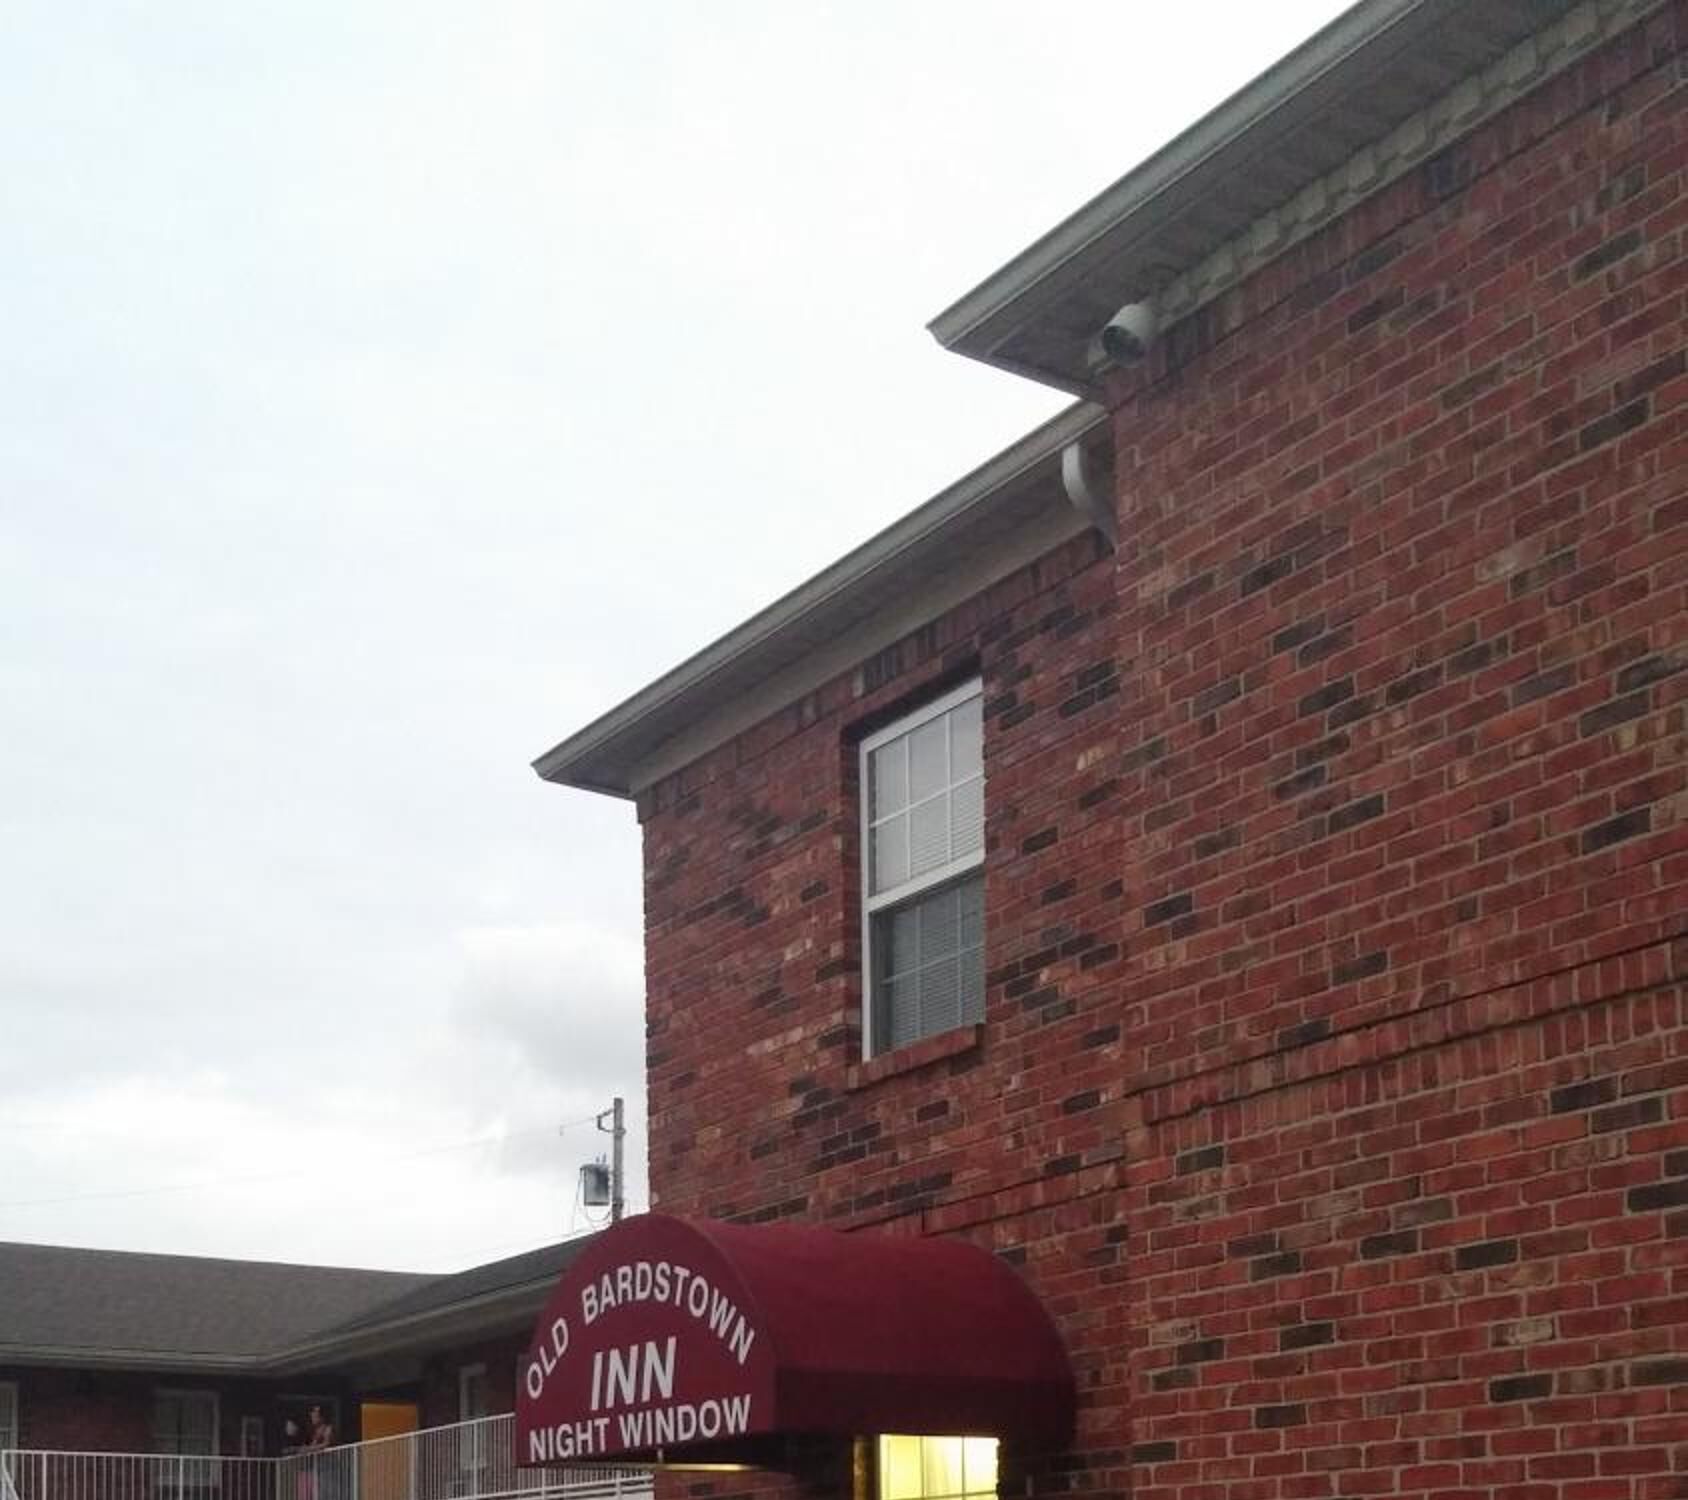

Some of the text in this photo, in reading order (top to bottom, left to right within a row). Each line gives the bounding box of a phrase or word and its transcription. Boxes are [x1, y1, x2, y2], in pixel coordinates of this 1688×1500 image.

[527, 1261, 755, 1399] OLD BARDSTOWN
[590, 1336, 677, 1411] INN
[529, 1394, 752, 1463] NIGHT WINDOW
